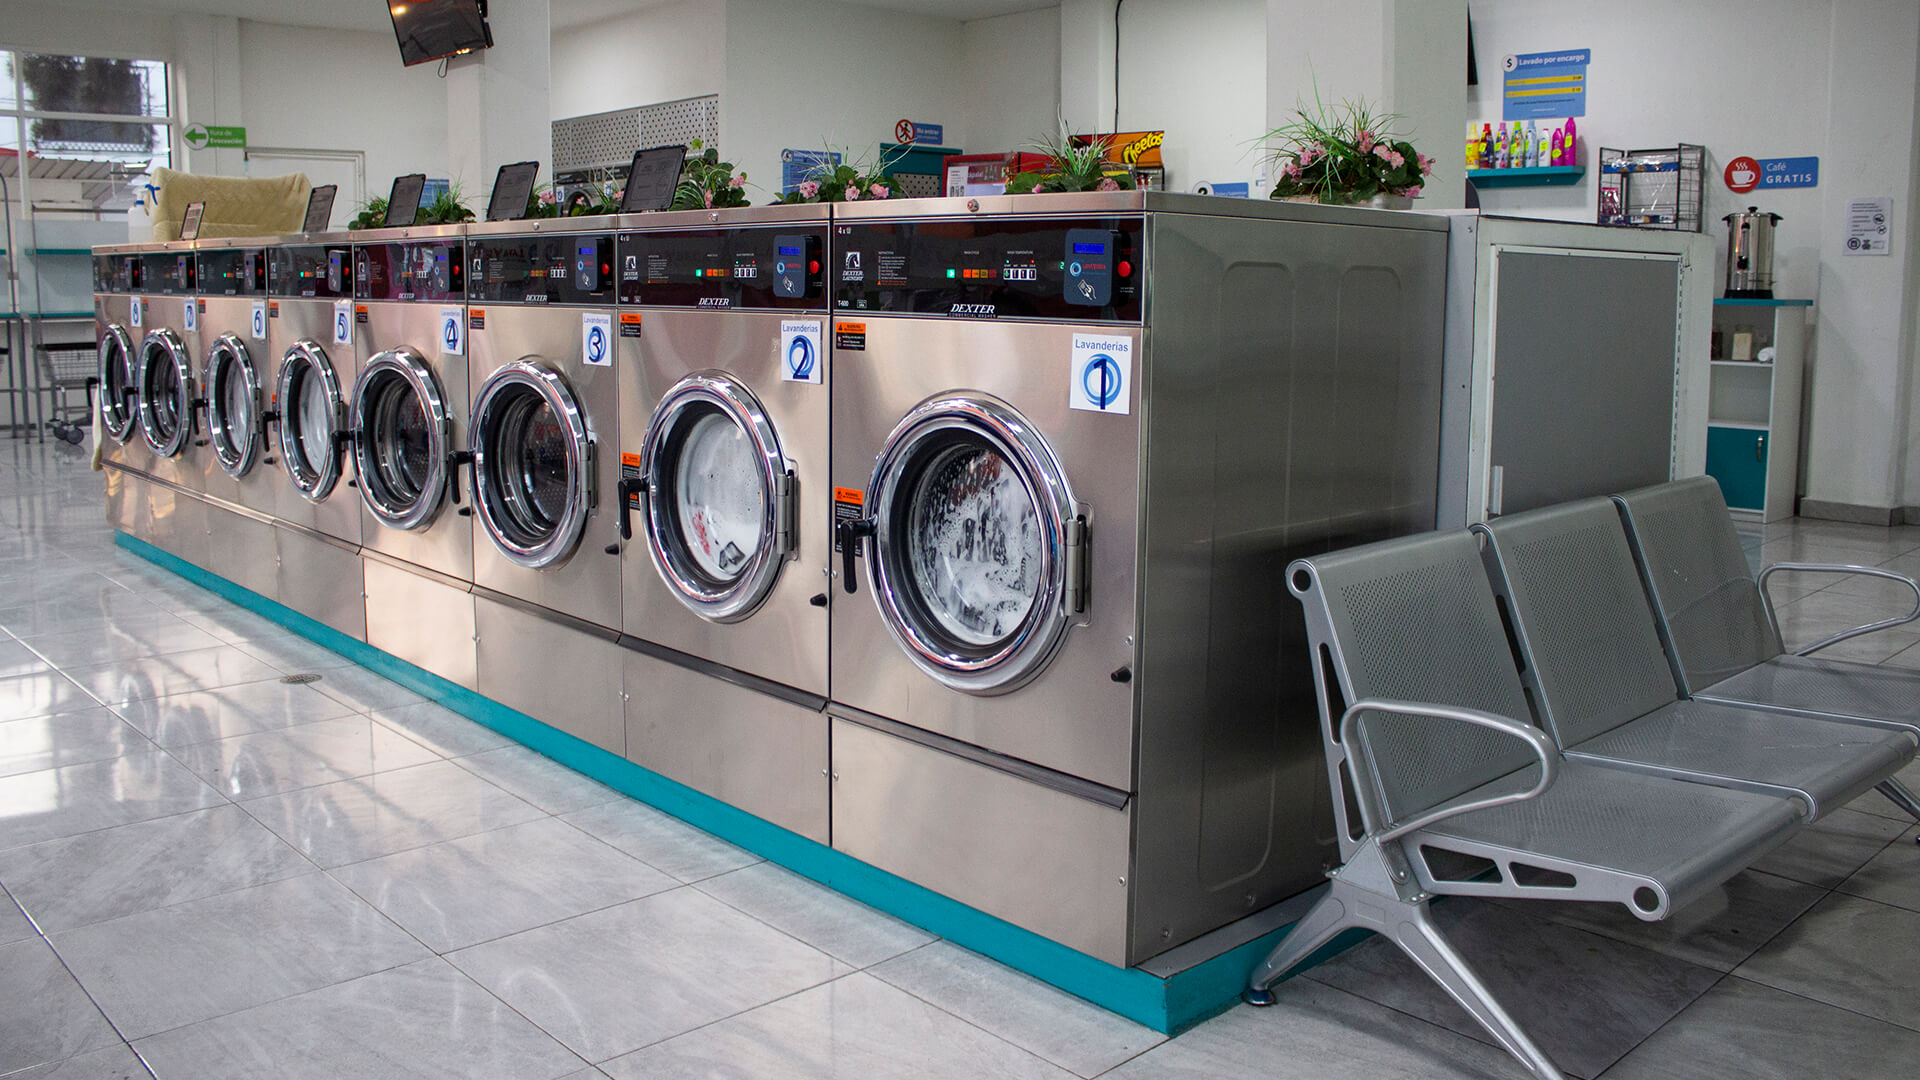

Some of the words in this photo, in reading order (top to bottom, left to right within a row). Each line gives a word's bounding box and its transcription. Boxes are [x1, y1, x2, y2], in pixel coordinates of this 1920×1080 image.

[1519, 56, 1543, 66] Lavado
[1544, 57, 1556, 65] por
[1557, 55, 1585, 63] encargo
[1123, 132, 1164, 164] Cheetos
[1766, 162, 1787, 172] Café
[1766, 174, 1812, 184] GRATIS
[698, 297, 730, 306] DEXTER
[950, 303, 996, 314] DEXTER
[337, 313, 348, 341] 5
[782, 324, 818, 333] Lavanderias
[446, 319, 458, 351] 4
[588, 327, 602, 363] 3
[1075, 339, 1129, 352] Lavanderias
[792, 337, 810, 380] 2
[1093, 358, 1107, 410] 1
